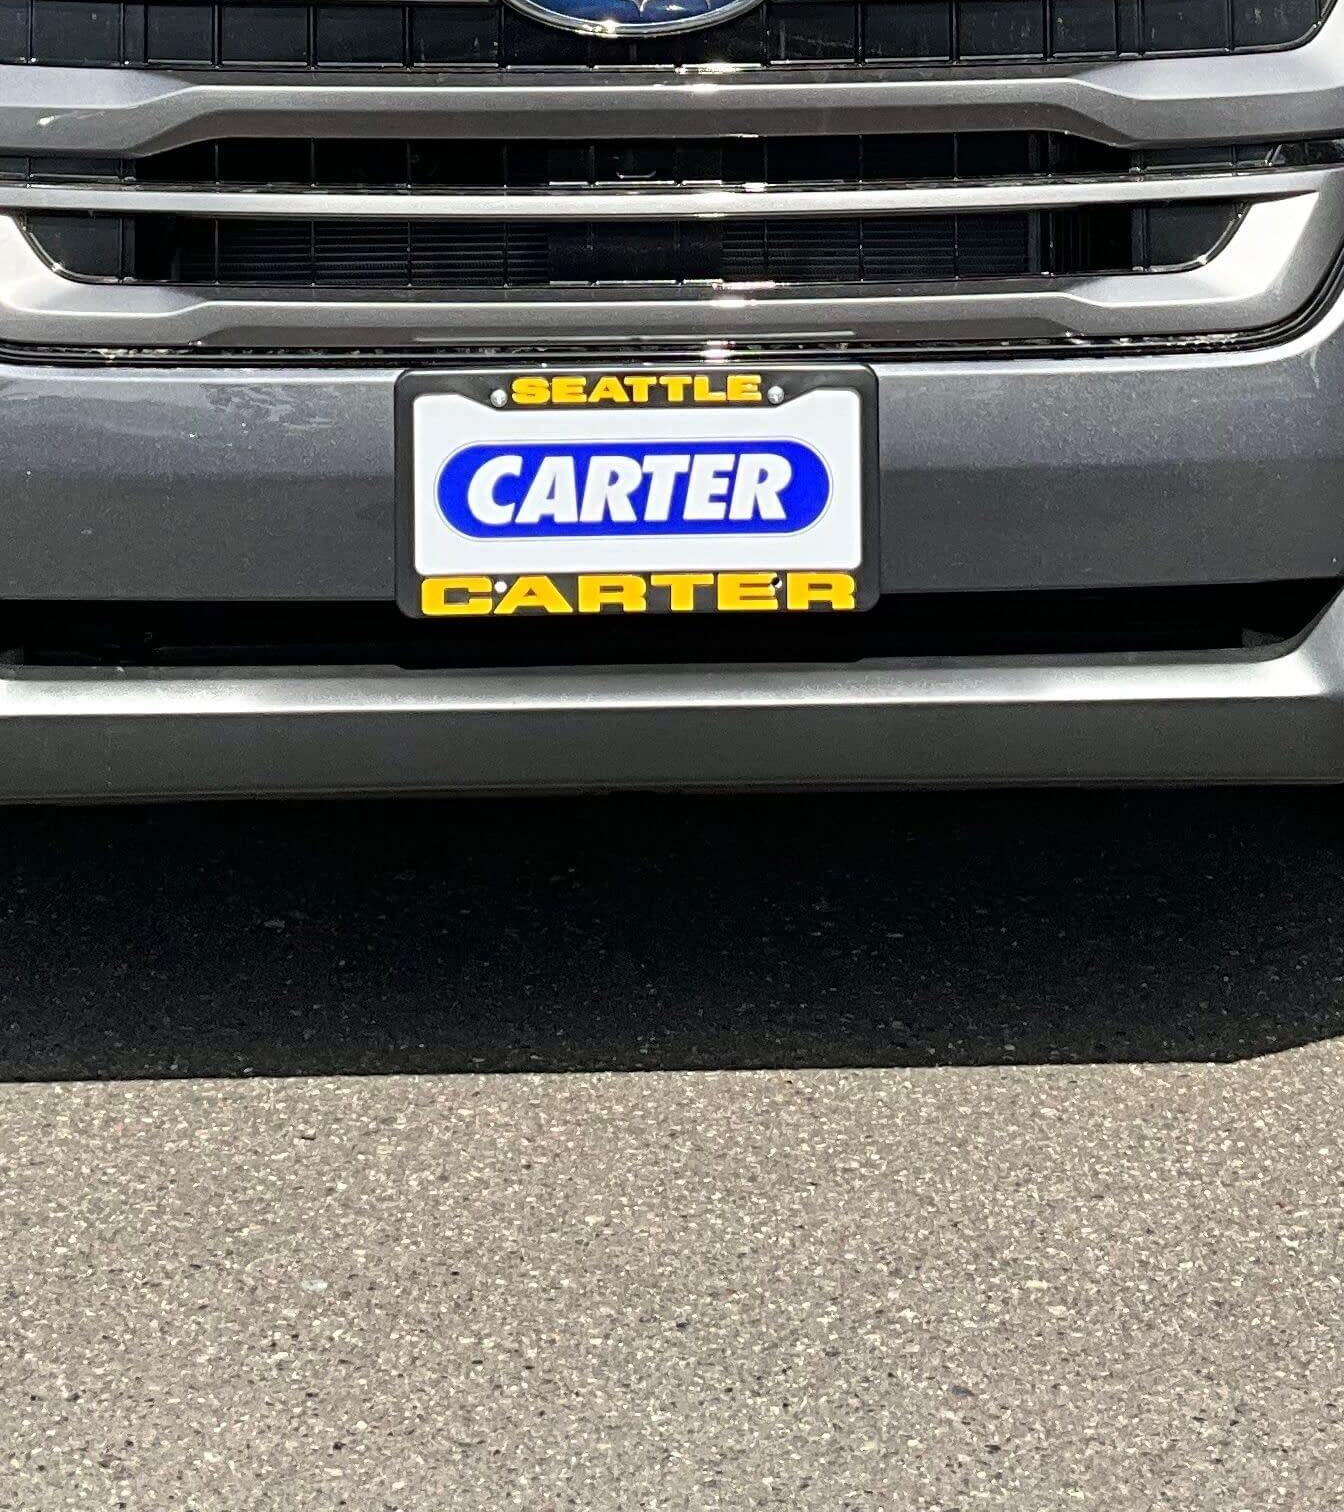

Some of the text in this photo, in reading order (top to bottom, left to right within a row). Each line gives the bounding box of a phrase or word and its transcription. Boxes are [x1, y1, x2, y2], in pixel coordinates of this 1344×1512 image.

[511, 374, 764, 405] SEATTLE
[467, 452, 793, 526] CARTER
[421, 571, 856, 616] CARTER
